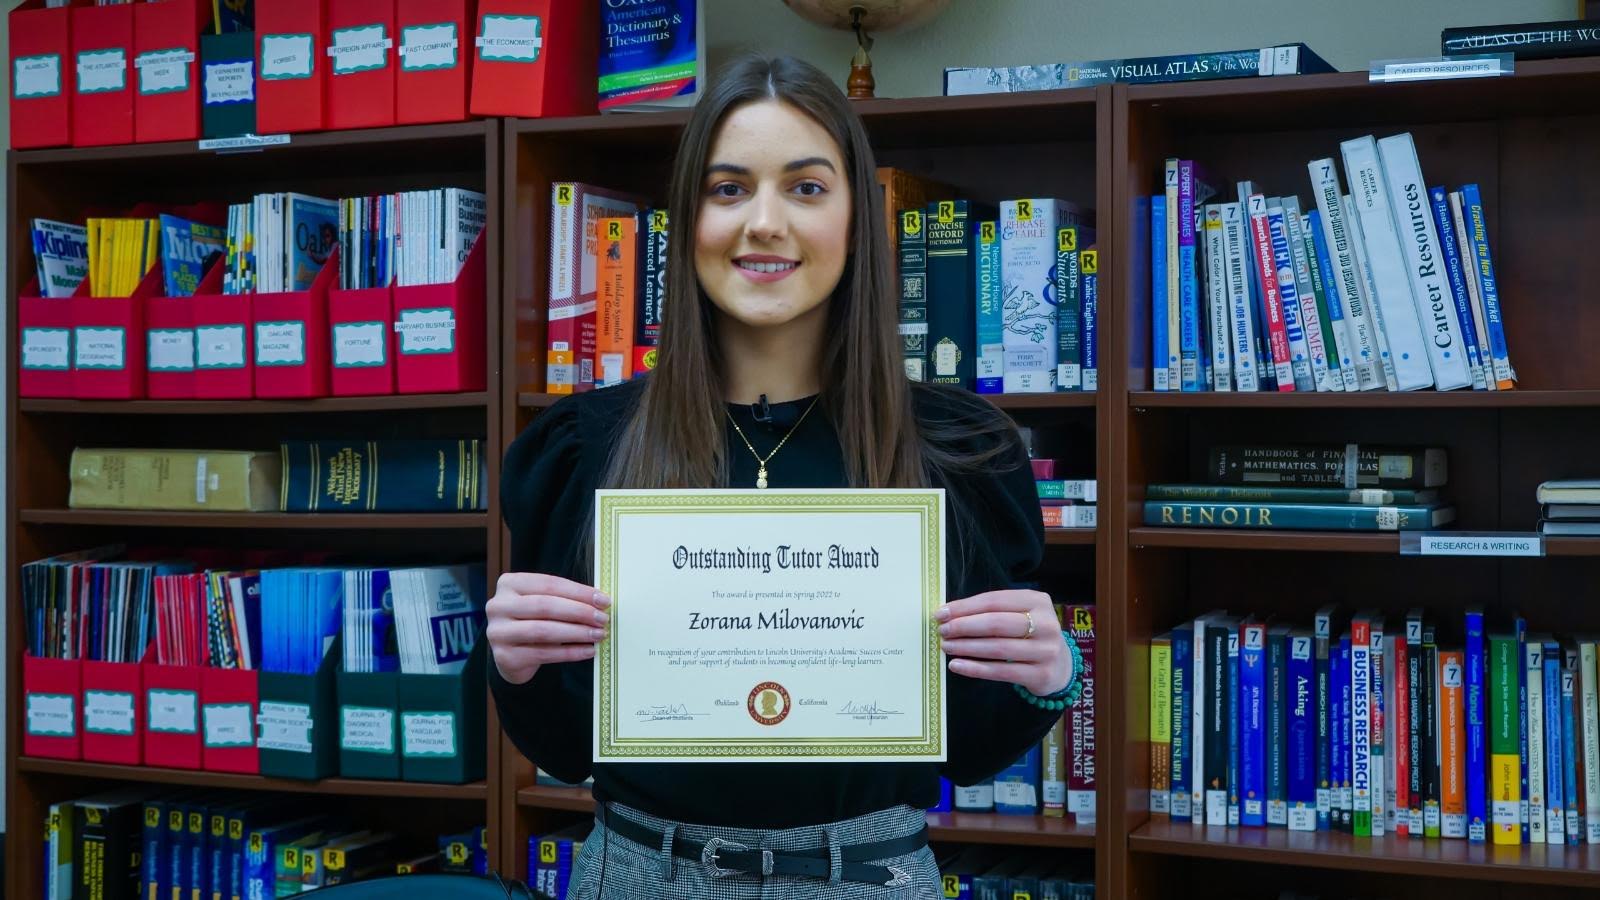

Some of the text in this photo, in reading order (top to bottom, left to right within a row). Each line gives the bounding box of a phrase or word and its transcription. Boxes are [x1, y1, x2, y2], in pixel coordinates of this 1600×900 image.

[608, 13, 682, 35] Dictionary &
[333, 41, 386, 54] FOREIGN AFFAIRS
[405, 42, 453, 53] FAST COMPANY
[497, 38, 535, 47] ECONOMIST
[606, 31, 670, 48] Thesaurus
[1462, 30, 1572, 48] ATLAS THE
[273, 55, 297, 65] FORBES
[1110, 60, 1209, 79] VISUAL ATLAS
[1168, 170, 1175, 181] 7
[1321, 166, 1330, 178] 7
[1367, 168, 1377, 193] CAREER
[559, 187, 569, 202] R
[1360, 170, 1373, 207] RESOURCES
[941, 204, 951, 218] R
[1018, 201, 1030, 216] R
[1182, 167, 1191, 237] EXPERT RESUMES
[1253, 199, 1260, 210] 7
[907, 214, 917, 228] R
[1228, 207, 1235, 218] 7
[609, 222, 619, 236] R
[929, 222, 964, 230] CONCISE
[929, 230, 964, 238] OXFORD
[982, 224, 993, 239] R
[1061, 231, 1073, 246] R
[1083, 256, 1095, 271] R
[1404, 184, 1452, 349] Career Resources
[1438, 204, 1454, 256] Health-Care
[1450, 258, 1467, 312] CareerVision
[1472, 205, 1499, 322] Cracking the New Job Market
[1058, 251, 1068, 303] Students
[1258, 243, 1280, 323] Methods for Business
[1312, 271, 1322, 291] PURPOSE
[1183, 249, 1193, 347] HEALTH CARE CAREERS
[1212, 237, 1224, 344] What Color Your Parachute?
[1342, 268, 1362, 318] DESCRIPTIONS
[645, 275, 655, 325] Learner's
[1231, 258, 1248, 353] MARKETING JOB HUNTERS
[1326, 288, 1339, 317] Success
[426, 321, 455, 329] BUSINESS
[603, 300, 612, 336] Customs
[1301, 297, 1323, 361] RESUMES
[413, 335, 436, 343] REVIEW
[1245, 450, 1299, 458] HANDBOOK
[327, 456, 337, 496] Webster's
[334, 452, 345, 501] Third New
[342, 447, 352, 505] International
[351, 452, 362, 500] Dictionary
[1161, 507, 1272, 526] RENOIR
[1430, 541, 1530, 551] RESEARCH & WRITING
[673, 544, 880, 573] Outstanding Tutor Award
[755, 591, 783, 600] presented
[793, 591, 814, 600] Spring
[688, 608, 864, 631] Zorana Milovanovic
[1077, 610, 1089, 625] R
[1318, 619, 1327, 631] 7
[439, 616, 473, 658] JVU
[1071, 629, 1095, 638] MBA
[1251, 631, 1258, 642] 7
[1409, 625, 1418, 636] 7
[1297, 640, 1306, 651] 7
[1373, 635, 1381, 646] 7
[649, 648, 656, 656] In
[657, 648, 692, 658] recognition
[693, 648, 700, 658] of
[701, 650, 716, 658] your
[717, 648, 757, 656] contribution
[765, 648, 789, 656] Lincoln
[790, 648, 827, 658] University's
[828, 648, 857, 656] Academic
[860, 648, 881, 656] Success
[883, 648, 904, 656] Center
[1159, 651, 1168, 666] The
[1531, 653, 1538, 665] 7
[681, 659, 698, 667] your
[699, 659, 723, 667] support
[724, 658, 731, 667] of
[767, 658, 796, 667] becoming
[798, 658, 827, 666] confident
[828, 658, 855, 667] life-long
[1158, 668, 1167, 692] Craft
[1410, 658, 1418, 687] DESIGNING
[1449, 668, 1457, 680] 7
[754, 682, 785, 695] LINCOLN
[1565, 678, 1573, 688] 7
[1295, 675, 1308, 716] Asking
[1469, 684, 1482, 725] Manual
[750, 709, 788, 724] UNIVERSITY
[1158, 700, 1168, 736] Research
[1251, 699, 1259, 729] Dictionary
[1354, 651, 1368, 789] BUSINESS RESEARCH
[1410, 699, 1418, 729] MANAGING
[1083, 678, 1095, 784] PORTABLE MBA
[1173, 668, 1183, 780] MIXED METHODS RESEARCH
[1374, 707, 1382, 745] research
[1072, 712, 1083, 777] REFERENCE
[1411, 764, 1419, 791] PROJECT
